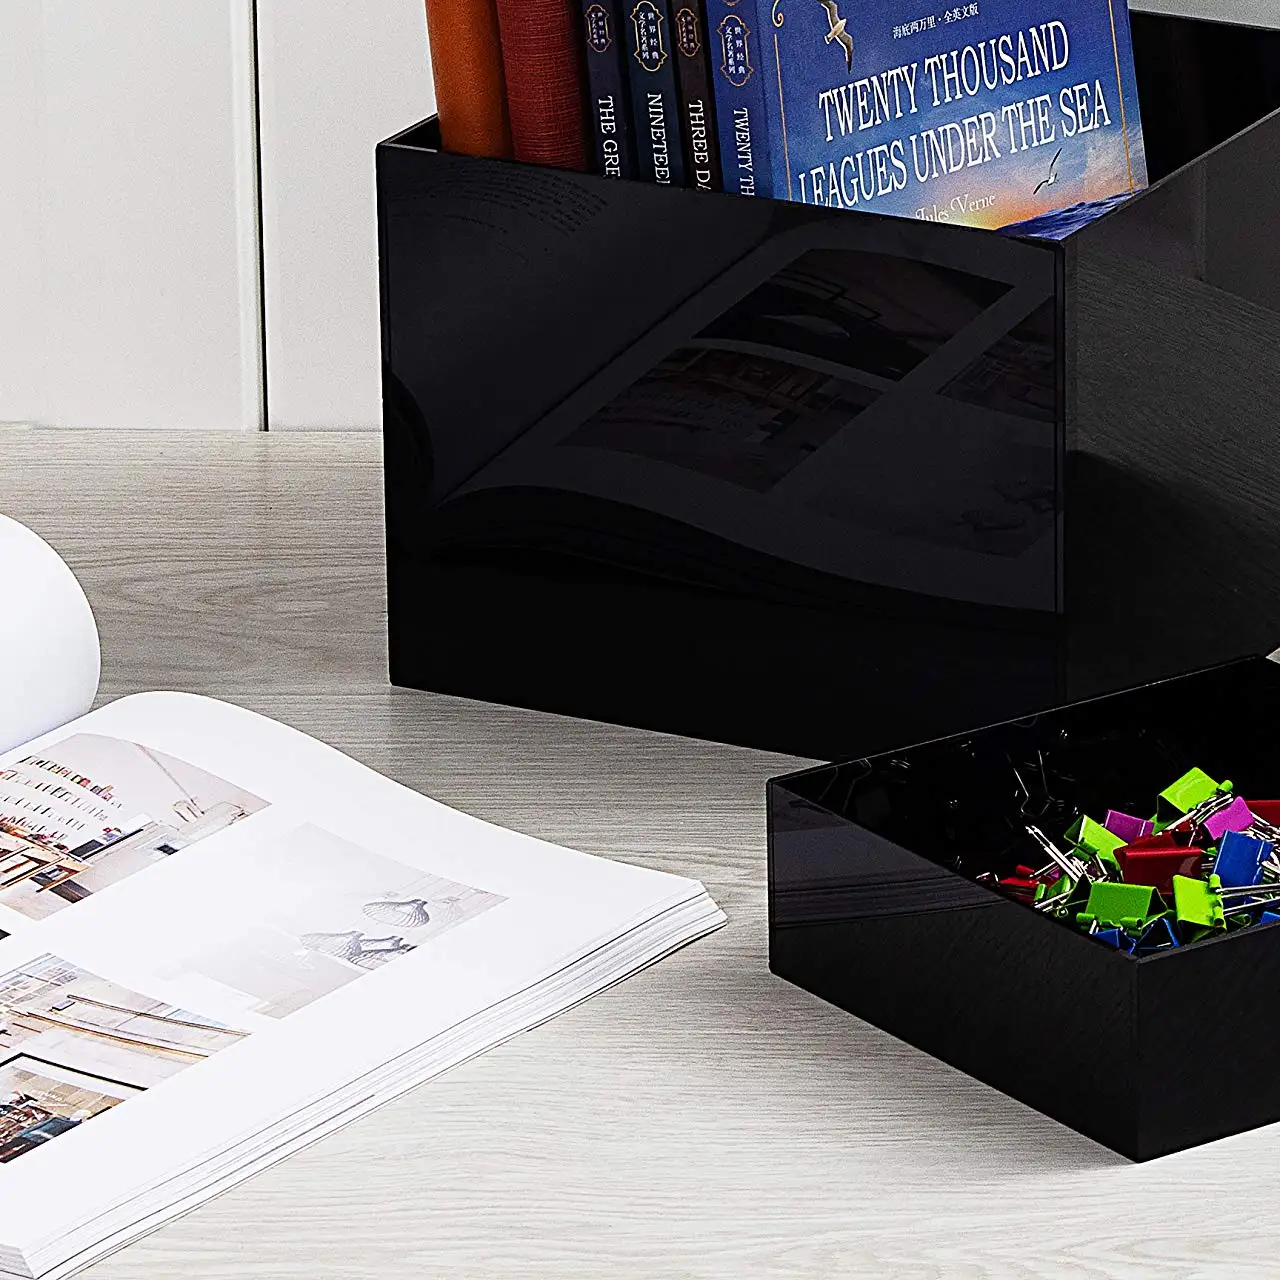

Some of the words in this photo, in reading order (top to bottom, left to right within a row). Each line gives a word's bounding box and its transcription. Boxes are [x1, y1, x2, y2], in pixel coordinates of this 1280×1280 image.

[818, 62, 918, 142] TWENTY
[924, 20, 1070, 107] THOUSAND
[598, 95, 617, 134] THE
[647, 93, 671, 185] NINETEE
[688, 99, 710, 164] THREE
[733, 107, 753, 172] TWENTY
[798, 138, 908, 208] LEAGUES
[909, 111, 1001, 183] UNDER
[1000, 93, 1056, 154] THE
[1059, 79, 1112, 138] SEA
[915, 204, 950, 223] Jules
[950, 193, 996, 215] Verne
